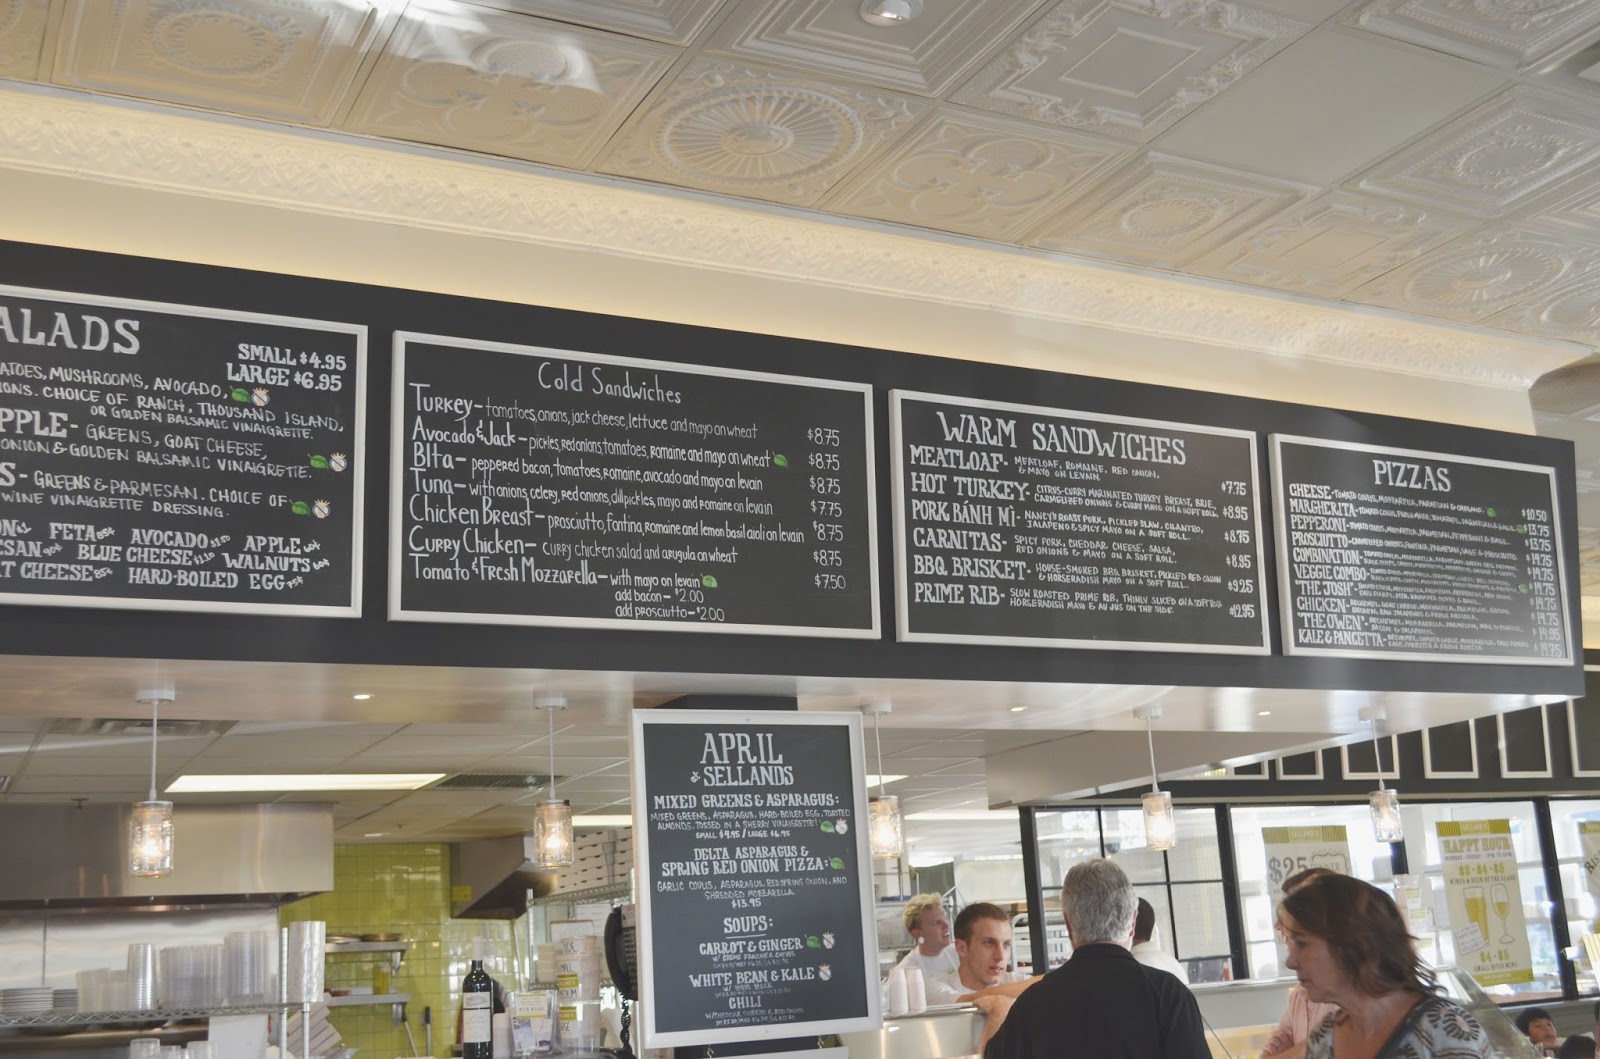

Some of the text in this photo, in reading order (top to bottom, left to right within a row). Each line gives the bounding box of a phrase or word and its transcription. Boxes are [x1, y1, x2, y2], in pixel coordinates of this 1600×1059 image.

[238, 343, 347, 371] SMALL $4.95
[50, 367, 228, 399] MUSHROOMS, AVOCADO,
[226, 363, 343, 391] LARGE $6.95
[538, 362, 682, 404] Cold Sandwiches
[43, 387, 101, 402] CHOICE
[106, 394, 129, 405] OF
[197, 402, 276, 421] THOUSAND
[285, 412, 344, 432] ISLAND,
[90, 406, 108, 417] OR
[111, 407, 163, 423] GOLDEN
[167, 414, 229, 429] BALSAMIC
[628, 412, 668, 430] lettuce
[807, 427, 840, 446] $8.75
[936, 411, 1187, 466] WARM SANDWICHES
[86, 424, 267, 460] GREENS, GOAT CHEESE,
[412, 415, 840, 470] Avocado wheat $8.75
[1, 439, 51, 454] ONION
[70, 444, 129, 461] GOLDEN
[137, 451, 211, 470] BALSAMIC
[1112, 466, 1128, 475] RED
[1372, 459, 1452, 492] PIZZAS
[34, 470, 91, 491] GREENS
[210, 488, 263, 504] CHOICE
[269, 495, 288, 507] OF
[737, 471, 763, 490] levain
[809, 475, 841, 495] $8.75
[911, 472, 947, 495] HOT
[1088, 488, 1133, 501] MARINATED
[1, 491, 45, 505] WINE
[50, 494, 144, 511] VINAIGRETTE
[745, 497, 773, 515] levain
[810, 499, 842, 517] $7.75
[410, 494, 479, 524] Chicken
[700, 520, 725, 538] lemon
[725, 520, 745, 540] basil
[778, 522, 804, 543] levain
[911, 499, 950, 522] PORK
[1108, 517, 1139, 528] PICKLED
[49, 522, 302, 555] FETA AVOCADO APPLE
[1014, 534, 1039, 546] SPICY
[1069, 539, 1108, 550] CHEDDAR
[1147, 529, 1166, 539] SOFT
[77, 544, 311, 572] BLUE CHEESE WALNUTS
[616, 542, 642, 560] salad
[708, 546, 738, 563] wheat
[1134, 552, 1153, 562] SOFT
[20, 561, 285, 590] CHEESE HARD-BOILED EGG
[409, 553, 470, 580] Tomato
[634, 577, 659, 592] mayo
[674, 573, 700, 588] levain
[913, 554, 948, 576] BBQ
[1294, 564, 1333, 579] VEGGIE
[615, 589, 632, 602] add
[914, 582, 965, 604] PRIME
[1299, 629, 1324, 644] KALE
[700, 732, 783, 764] APRIL
[703, 765, 795, 787] SELLANDS
[653, 795, 697, 810] MIXED
[702, 794, 751, 809] GREENS
[650, 812, 675, 822] MIXED
[696, 831, 717, 839] SMALL
[1442, 838, 1480, 853] HAPPY
[693, 846, 798, 861] DELTA ASPARAGUS
[662, 861, 709, 877] SPRING
[713, 859, 738, 874] RED
[740, 858, 779, 874] ONION
[657, 881, 685, 892] GARLIC
[704, 891, 745, 901] SHREDDED
[731, 898, 762, 908] $13.95
[699, 938, 803, 955] CARROT GINGER
[689, 967, 815, 988] WHITE BEAN KALE
[729, 996, 762, 1009] CHILI
